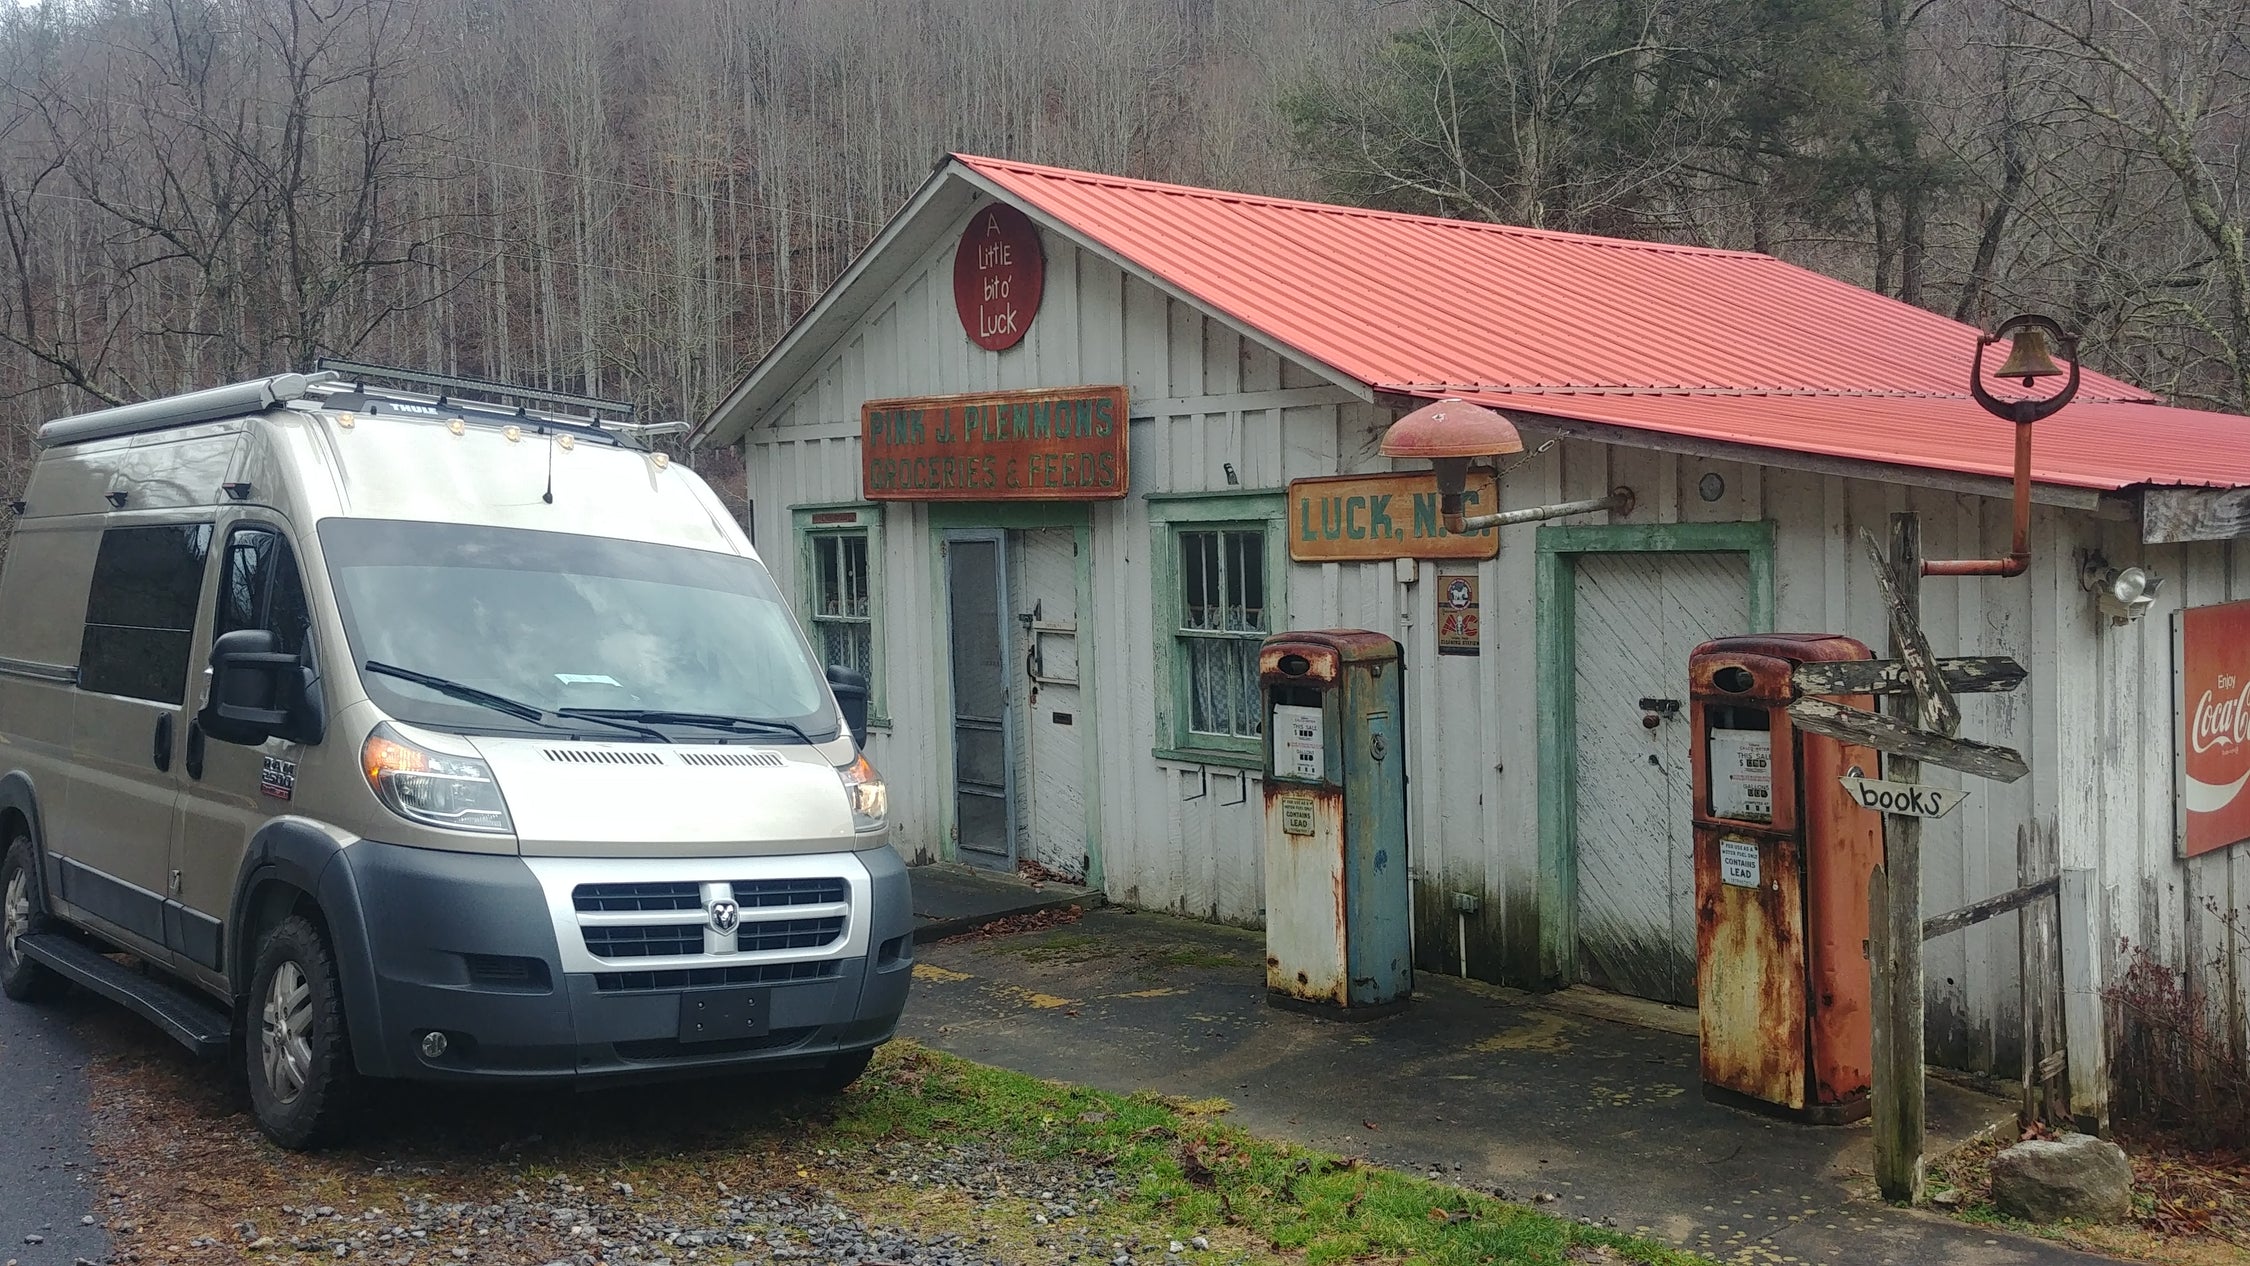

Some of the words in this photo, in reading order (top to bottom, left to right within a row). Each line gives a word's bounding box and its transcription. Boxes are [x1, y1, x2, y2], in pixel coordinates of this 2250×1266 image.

[985, 212, 1001, 238] A
[984, 275, 1000, 301] bit
[389, 403, 439, 415] THULE
[870, 409, 926, 448] PINK
[935, 406, 957, 443] J.
[964, 397, 1114, 442] PLEMMONS
[870, 454, 998, 490] GROCERIES
[1006, 458, 1022, 489] &
[1028, 451, 1115, 488] FEEDS
[1301, 493, 1404, 544] LUCK,
[1441, 614, 1478, 637] AC
[2217, 674, 2237, 690] Enjoy
[263, 755, 297, 775] RAM
[1737, 752, 1753, 760] THIS
[1859, 781, 1942, 816] books
[1286, 811, 1311, 819] CONTAINS
[1290, 819, 1308, 828] LEAD
[1725, 857, 1756, 869] CONTAINS
[1730, 867, 1752, 879] LEAD
